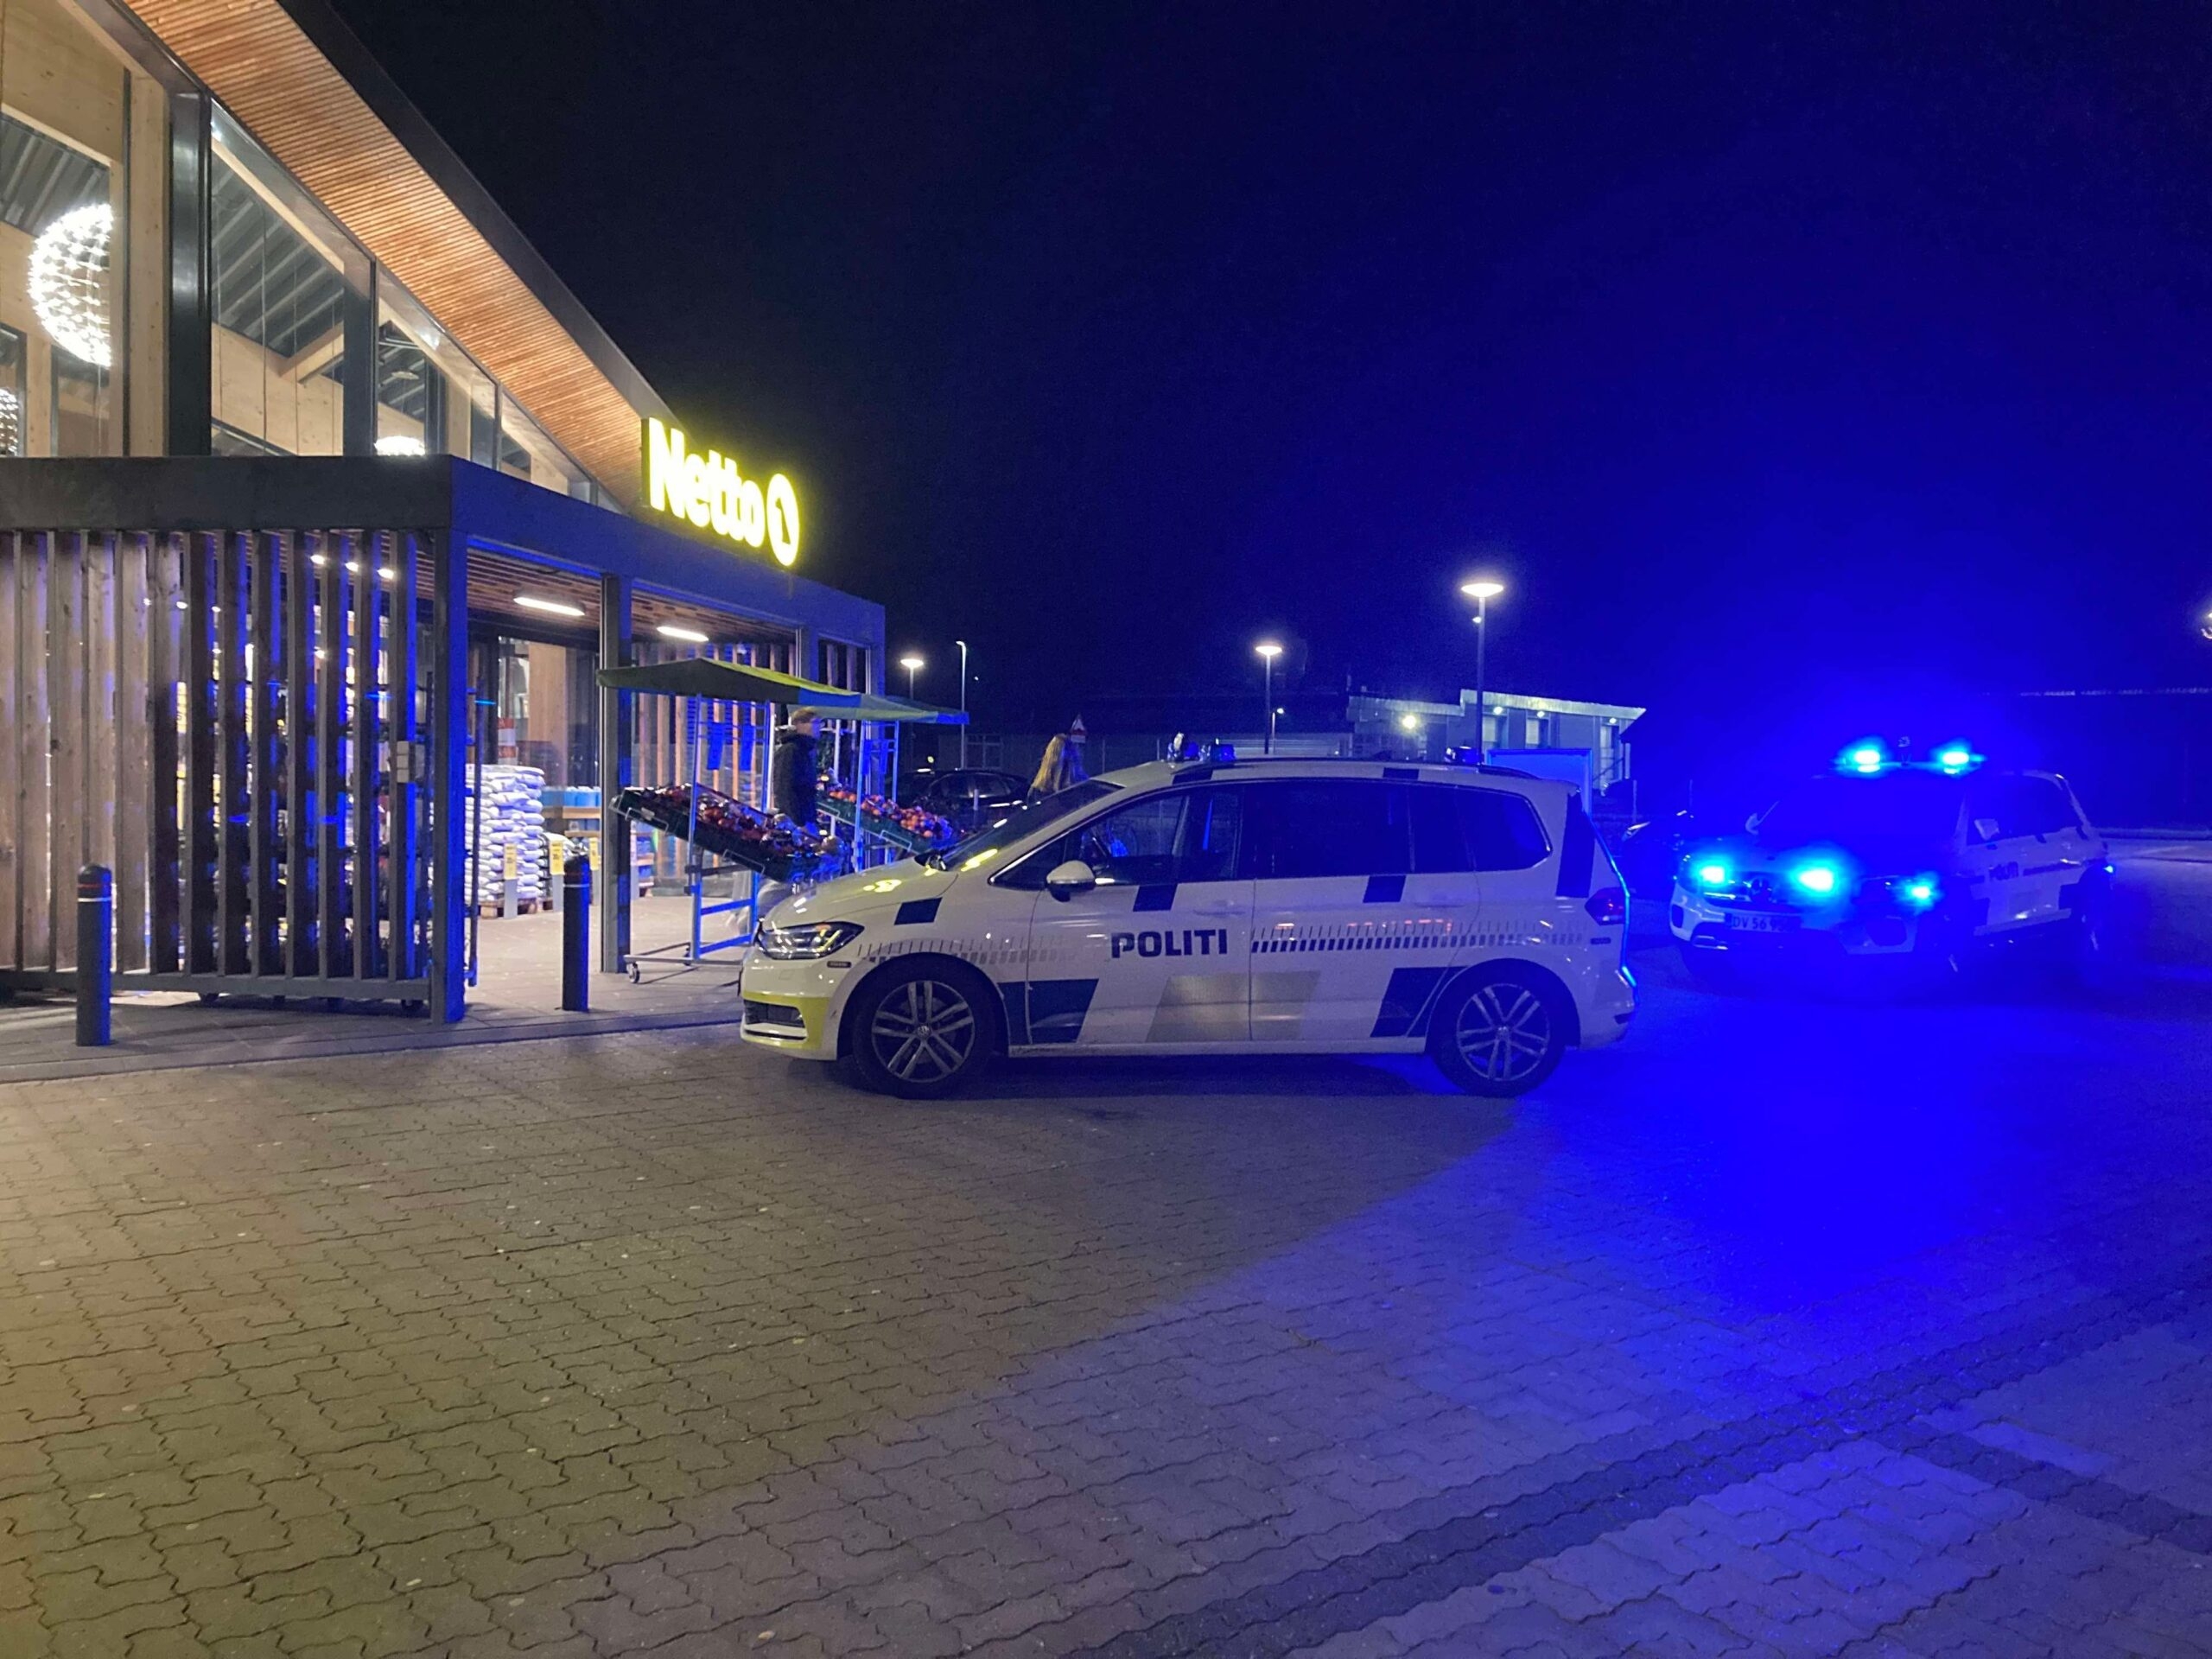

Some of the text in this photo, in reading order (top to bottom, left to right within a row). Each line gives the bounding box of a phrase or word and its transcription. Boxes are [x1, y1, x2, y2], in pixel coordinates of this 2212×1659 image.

[648, 416, 766, 548] Netto
[1732, 916, 1749, 929] DV
[1752, 918, 1767, 930] 56
[1111, 929, 1228, 958] POLITI
